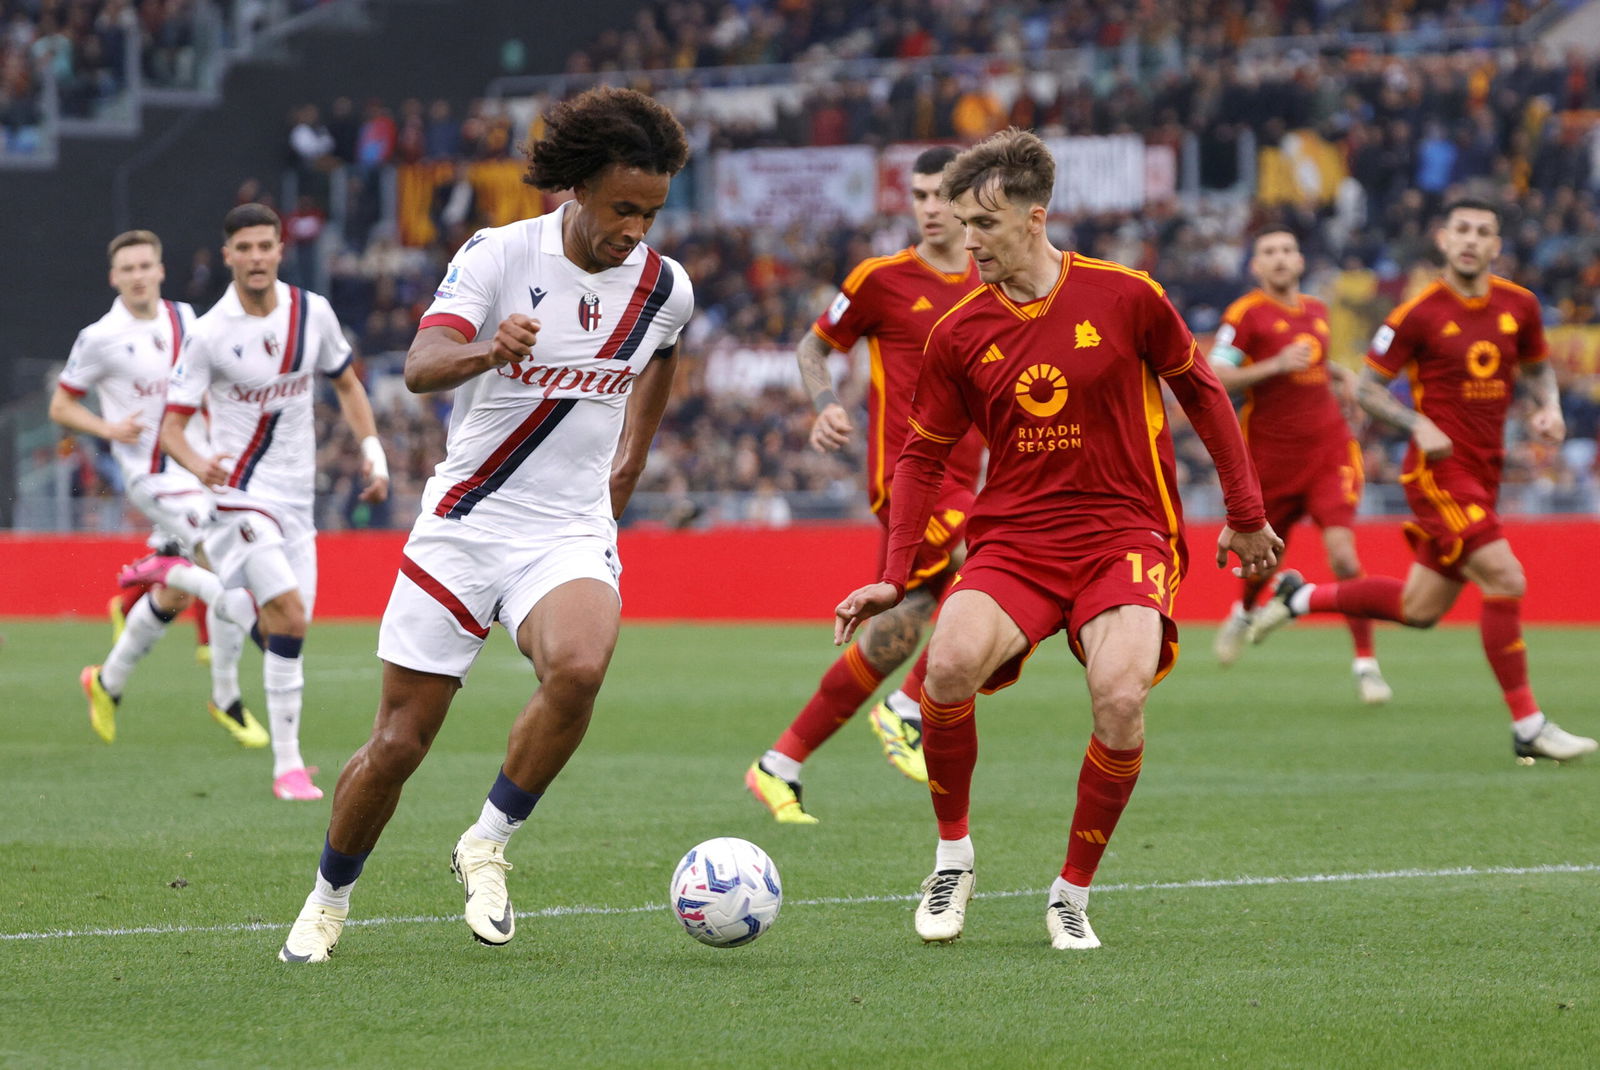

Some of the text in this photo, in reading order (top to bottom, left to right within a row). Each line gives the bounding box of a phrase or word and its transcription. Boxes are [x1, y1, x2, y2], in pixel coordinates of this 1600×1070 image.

[1018, 423, 1081, 439] RIYADH
[1017, 438, 1082, 453] SEASON
[1126, 552, 1166, 600] 14
